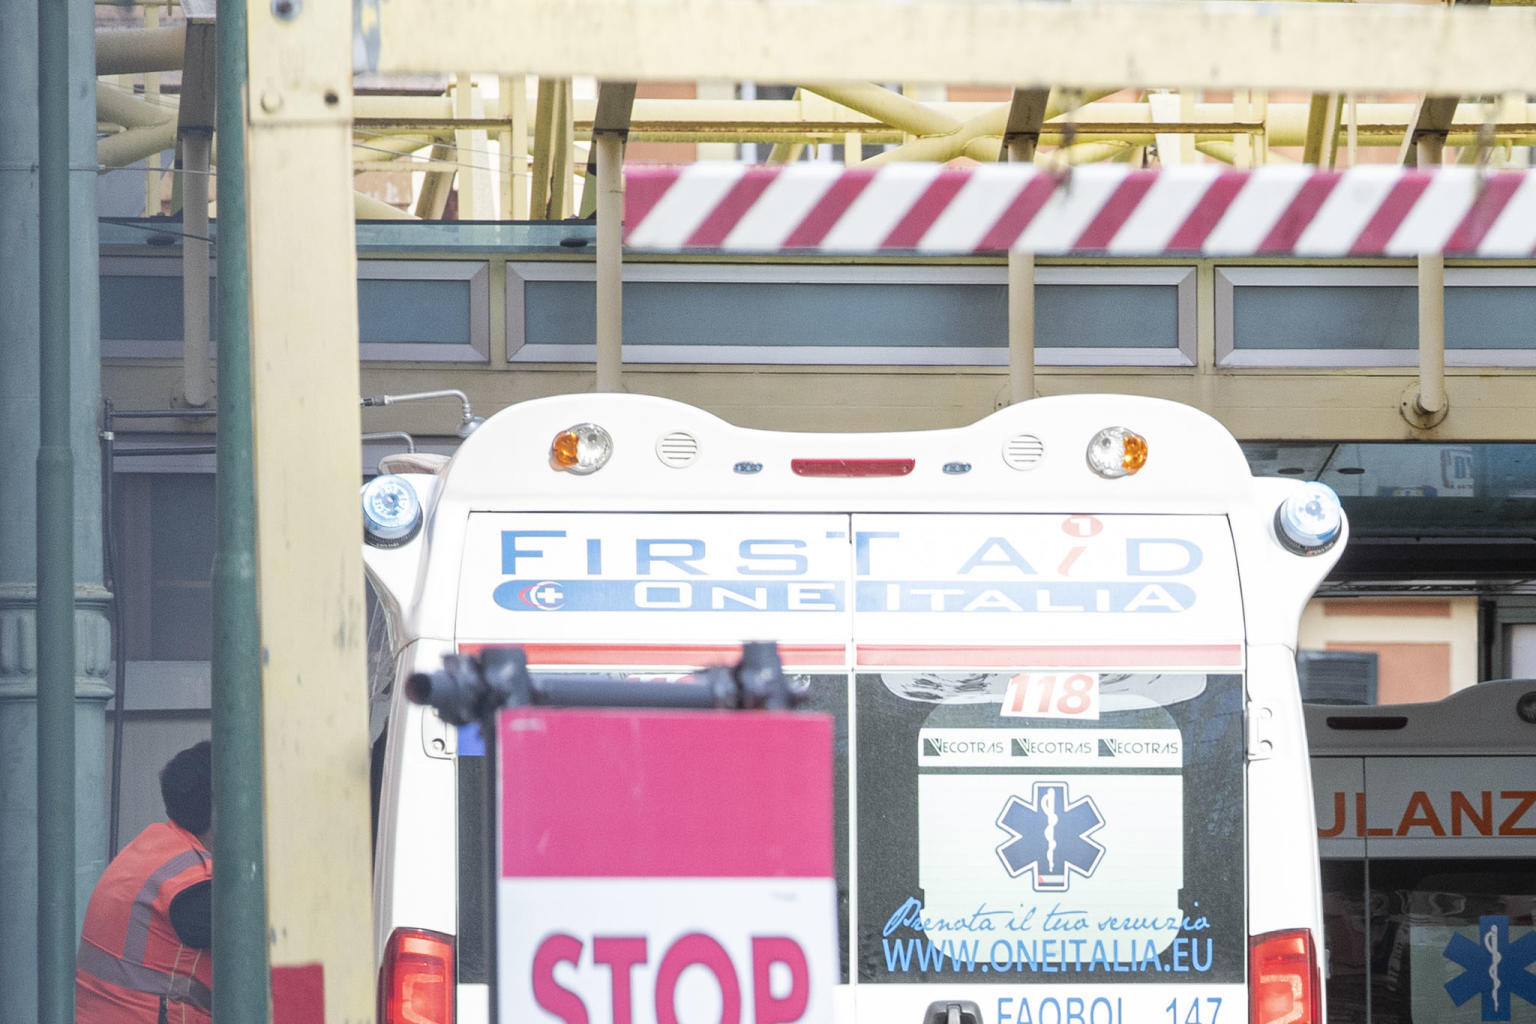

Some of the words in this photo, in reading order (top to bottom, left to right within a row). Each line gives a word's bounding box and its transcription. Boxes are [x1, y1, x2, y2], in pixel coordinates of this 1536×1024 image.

[501, 530, 900, 575] FIRST
[634, 581, 837, 611] ONE
[886, 583, 1186, 613] ITALIA
[1009, 673, 1096, 714] 118
[883, 896, 996, 937] Prenota
[1005, 903, 1037, 931] il
[1043, 902, 1088, 931] tuo
[1098, 901, 1210, 931] servizio
[882, 938, 1213, 972] WWW.ONEITALIA.EU
